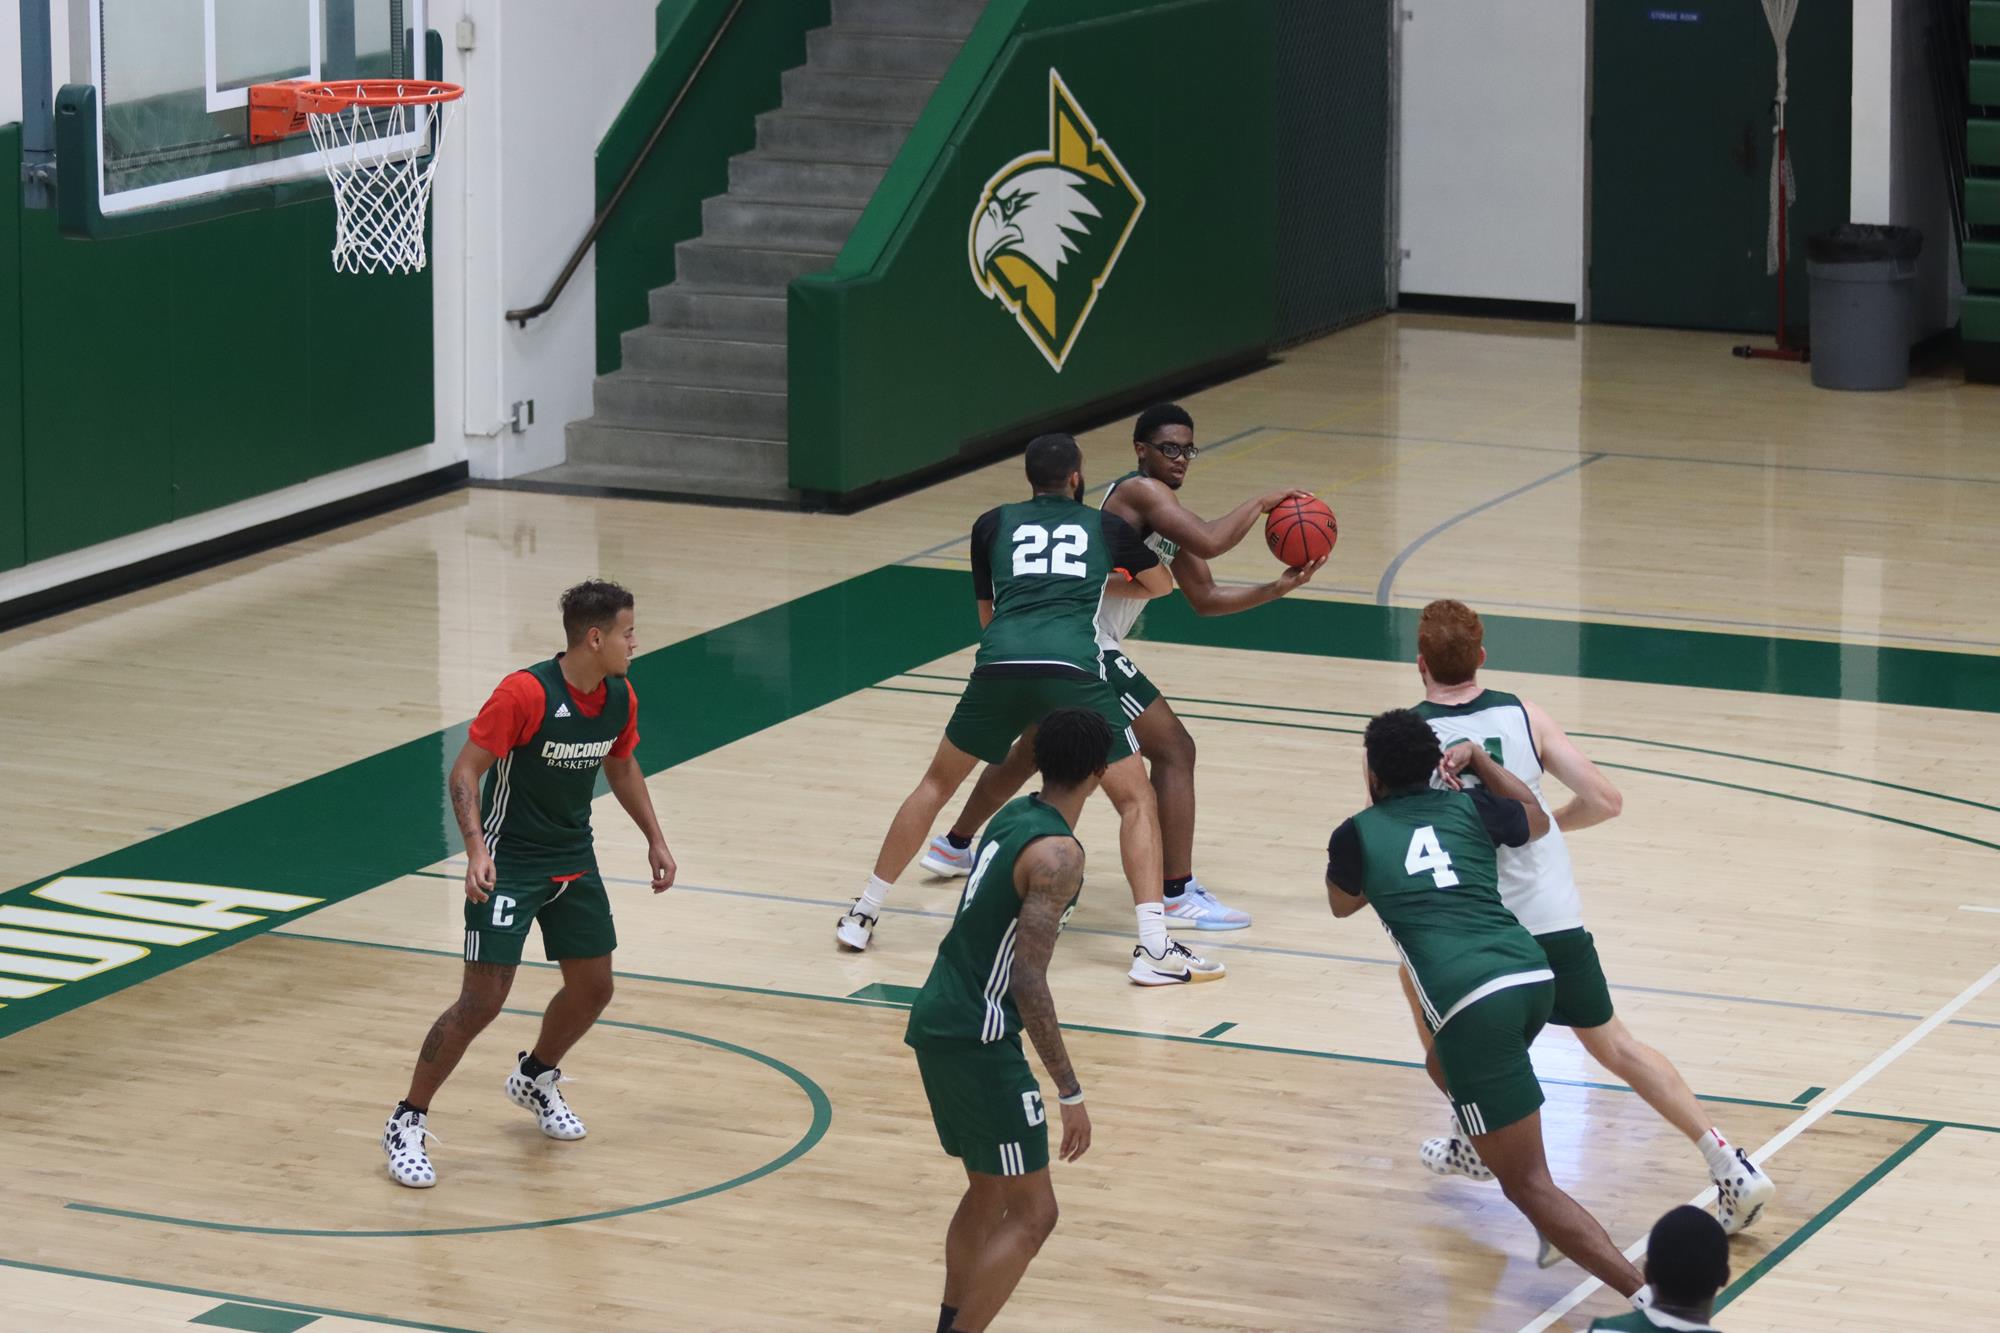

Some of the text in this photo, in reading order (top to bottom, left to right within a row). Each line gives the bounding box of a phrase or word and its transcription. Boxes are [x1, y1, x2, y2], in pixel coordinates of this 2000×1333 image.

[1012, 524, 1089, 579] 22
[1404, 825, 1460, 888] 4
[492, 895, 516, 926] C
[1021, 1090, 1045, 1127] C
